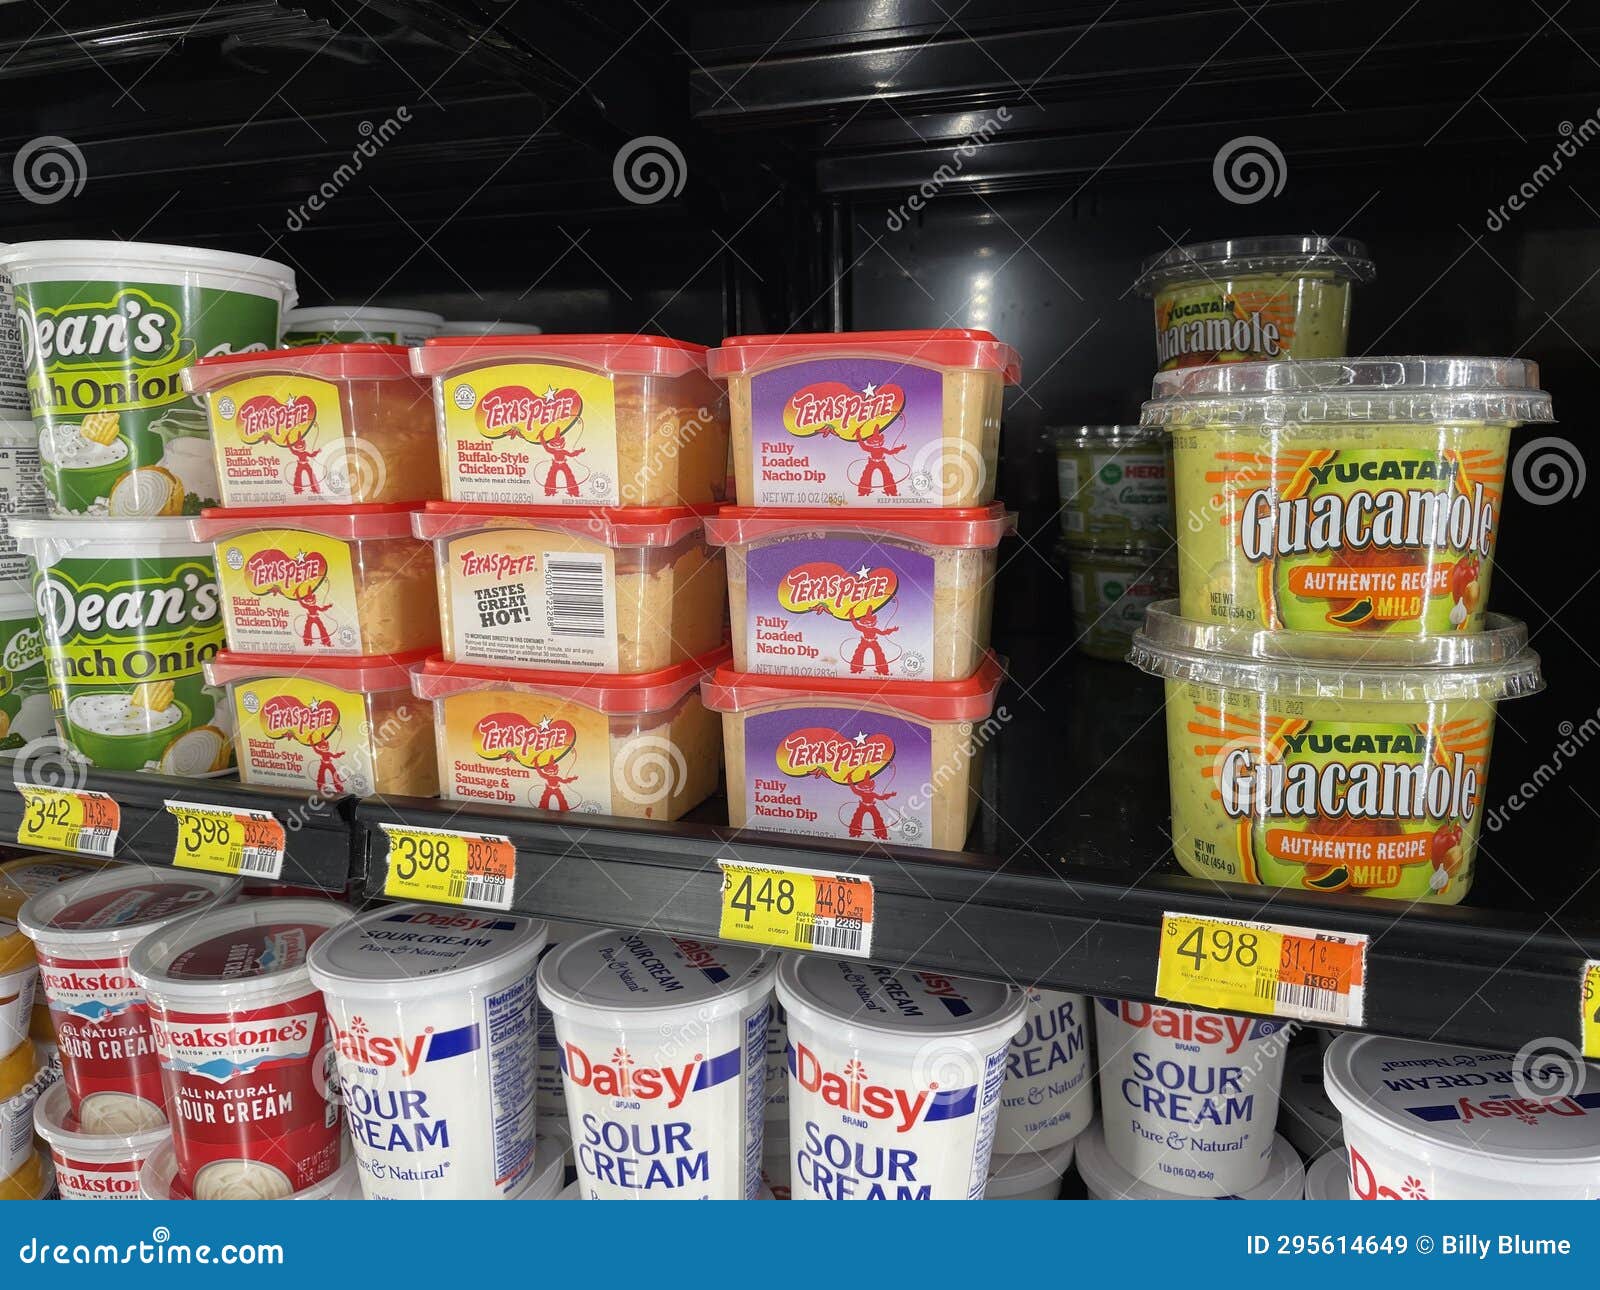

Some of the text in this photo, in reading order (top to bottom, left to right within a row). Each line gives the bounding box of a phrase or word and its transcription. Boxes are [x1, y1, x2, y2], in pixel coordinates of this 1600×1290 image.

[1158, 311, 1281, 362] uacamole
[457, 440, 495, 452] Blazin'
[761, 442, 794, 456] Fully
[226, 456, 281, 469] Buffalo-Style
[458, 452, 529, 465] Buffalo-Style
[762, 456, 809, 469] Loaded
[227, 467, 279, 480] Chicken Dip
[459, 464, 526, 478] Chicken Dip
[762, 470, 827, 484] Nacho Dip
[1309, 460, 1459, 486] YUCATAN
[459, 477, 473, 485] With
[474, 477, 491, 485] white
[507, 477, 531, 486] chicken
[460, 491, 511, 503] NET 10 OZ
[762, 492, 820, 505] NET 10 OZ
[1241, 482, 1494, 561] Guacamole
[1303, 569, 1449, 591] AUTHENTIC RECIPE
[474, 583, 525, 600] TASTES
[1210, 592, 1223, 604] NET
[36, 574, 219, 641] Dean's
[232, 596, 260, 607] Blazin'
[477, 595, 527, 612] GREAT
[1377, 597, 1422, 617] MILD
[234, 606, 289, 618] Buffalo-Style
[479, 606, 531, 628] HOT!
[1218, 604, 1228, 617] OZ
[235, 617, 288, 630] Chicken Dip
[756, 615, 789, 631] Fully
[756, 629, 804, 644] Loaded
[756, 643, 820, 660] Nacho Dip
[755, 663, 813, 678] NET 10 OZ
[906, 658, 919, 669] 2g
[248, 738, 276, 750] Blazin'
[1283, 734, 1436, 755] YUCATAN
[250, 748, 304, 762] Buffalo-Style
[251, 758, 303, 773] Chicken Dip
[454, 760, 530, 779] Southwestern
[455, 773, 510, 790] Sausage &
[755, 779, 788, 794] Fully
[1220, 749, 1478, 821] Guacamole
[456, 786, 516, 804] Cheese Dip
[755, 792, 802, 806] Loaded
[755, 806, 818, 822] Nacho Dip
[904, 824, 917, 834] 2g
[1195, 838, 1216, 854] NET WT
[1280, 836, 1426, 860] AUTHENTIC RECIPE
[1201, 853, 1237, 875] OZ (454 g)
[483, 874, 506, 885] 0593
[1353, 865, 1399, 885] MILD
[409, 911, 489, 929] Daisy
[836, 917, 863, 930] 2285
[361, 930, 493, 948] SOUR CREAM
[412, 946, 463, 959] Natural
[620, 935, 684, 992] SOUR CREAM
[1304, 975, 1338, 991] 1169
[82, 1024, 147, 1039] NATURAL
[1121, 1001, 1253, 1054] Daisy
[59, 1033, 93, 1060] SOUR
[1004, 1024, 1085, 1081] REAM
[1175, 1042, 1200, 1053] BRAND
[1132, 1052, 1243, 1094] SOUR
[1387, 1060, 1449, 1070] Natural
[566, 1042, 697, 1110] Daisy
[1383, 1073, 1489, 1092] CREAM
[181, 1083, 277, 1100] ALL NATURAL
[797, 1041, 930, 1133] Daisy
[1027, 1066, 1084, 1106] & Natural
[340, 1075, 430, 1121] SOUR
[615, 1100, 641, 1110] BRAND
[1121, 1078, 1254, 1126] CREAM
[174, 1091, 293, 1125] SOUR CREAM
[1458, 1096, 1587, 1121] Daisy
[349, 1108, 451, 1153] REAM
[842, 1115, 868, 1129] BRAND
[582, 1113, 694, 1156] SOUR
[1132, 1120, 1243, 1152] Pure & Natural
[805, 1120, 919, 1182] SOUR
[371, 1158, 445, 1181] & Natural
[579, 1143, 710, 1190] CREAM
[1173, 1164, 1215, 1181] (16 OZ) 454g
